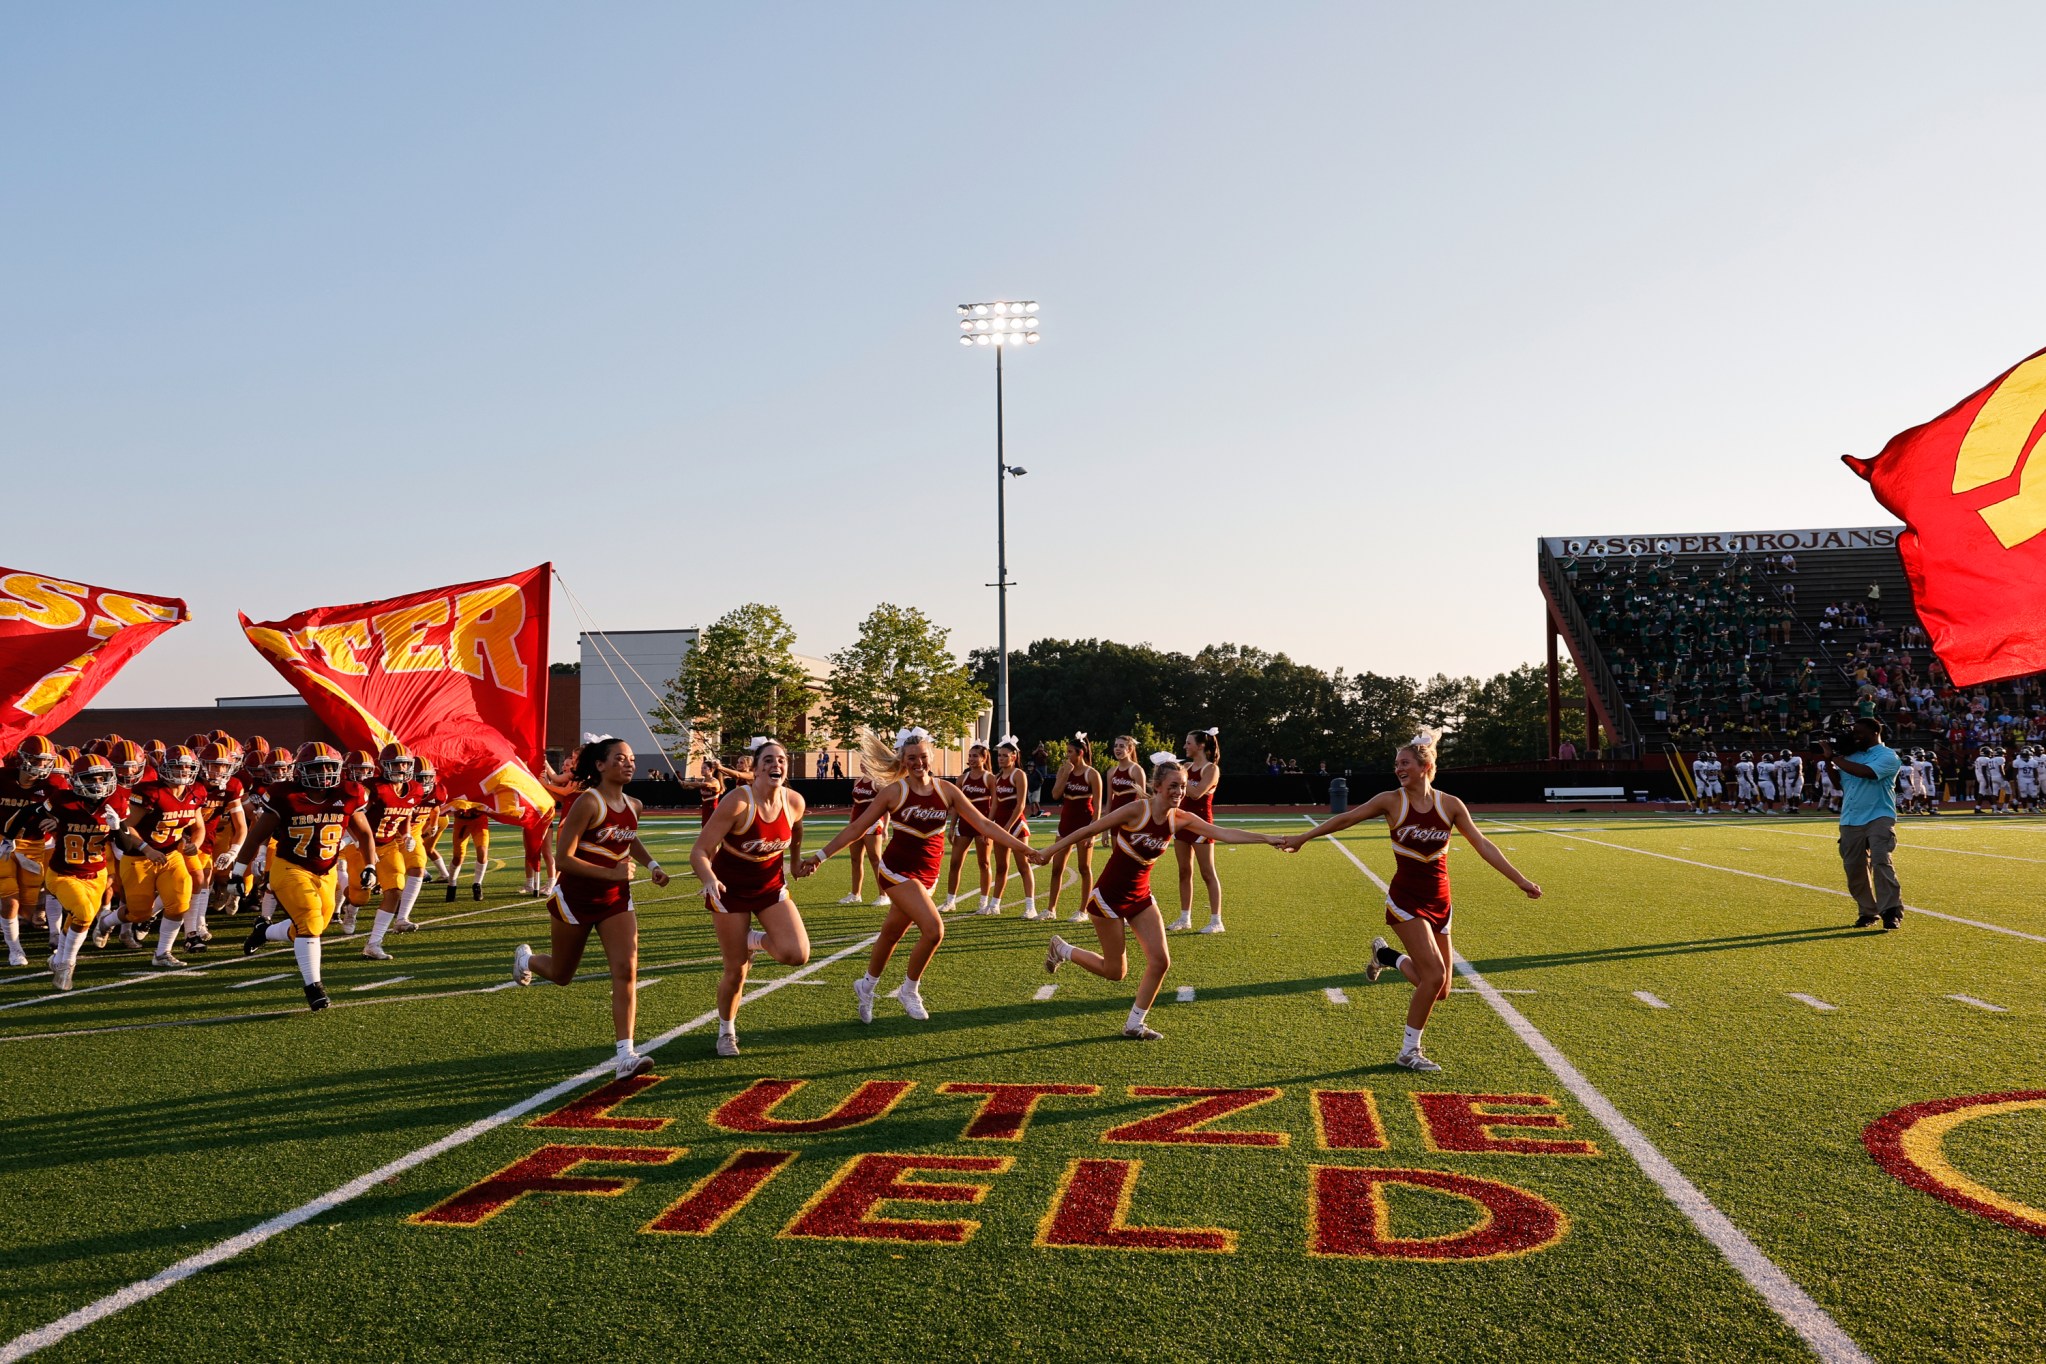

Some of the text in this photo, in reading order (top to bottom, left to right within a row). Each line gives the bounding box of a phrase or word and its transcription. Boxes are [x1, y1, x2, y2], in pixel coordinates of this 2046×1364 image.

[1734, 529, 1895, 551] TROJANS
[291, 813, 345, 826] TROJANS
[288, 824, 344, 861] 79
[597, 825, 638, 845] Trojan
[1396, 823, 1450, 843] Trojan
[741, 836, 792, 854] Trojan
[522, 1075, 1603, 1157] LUTZIE
[404, 1141, 1573, 1263] FIELD
